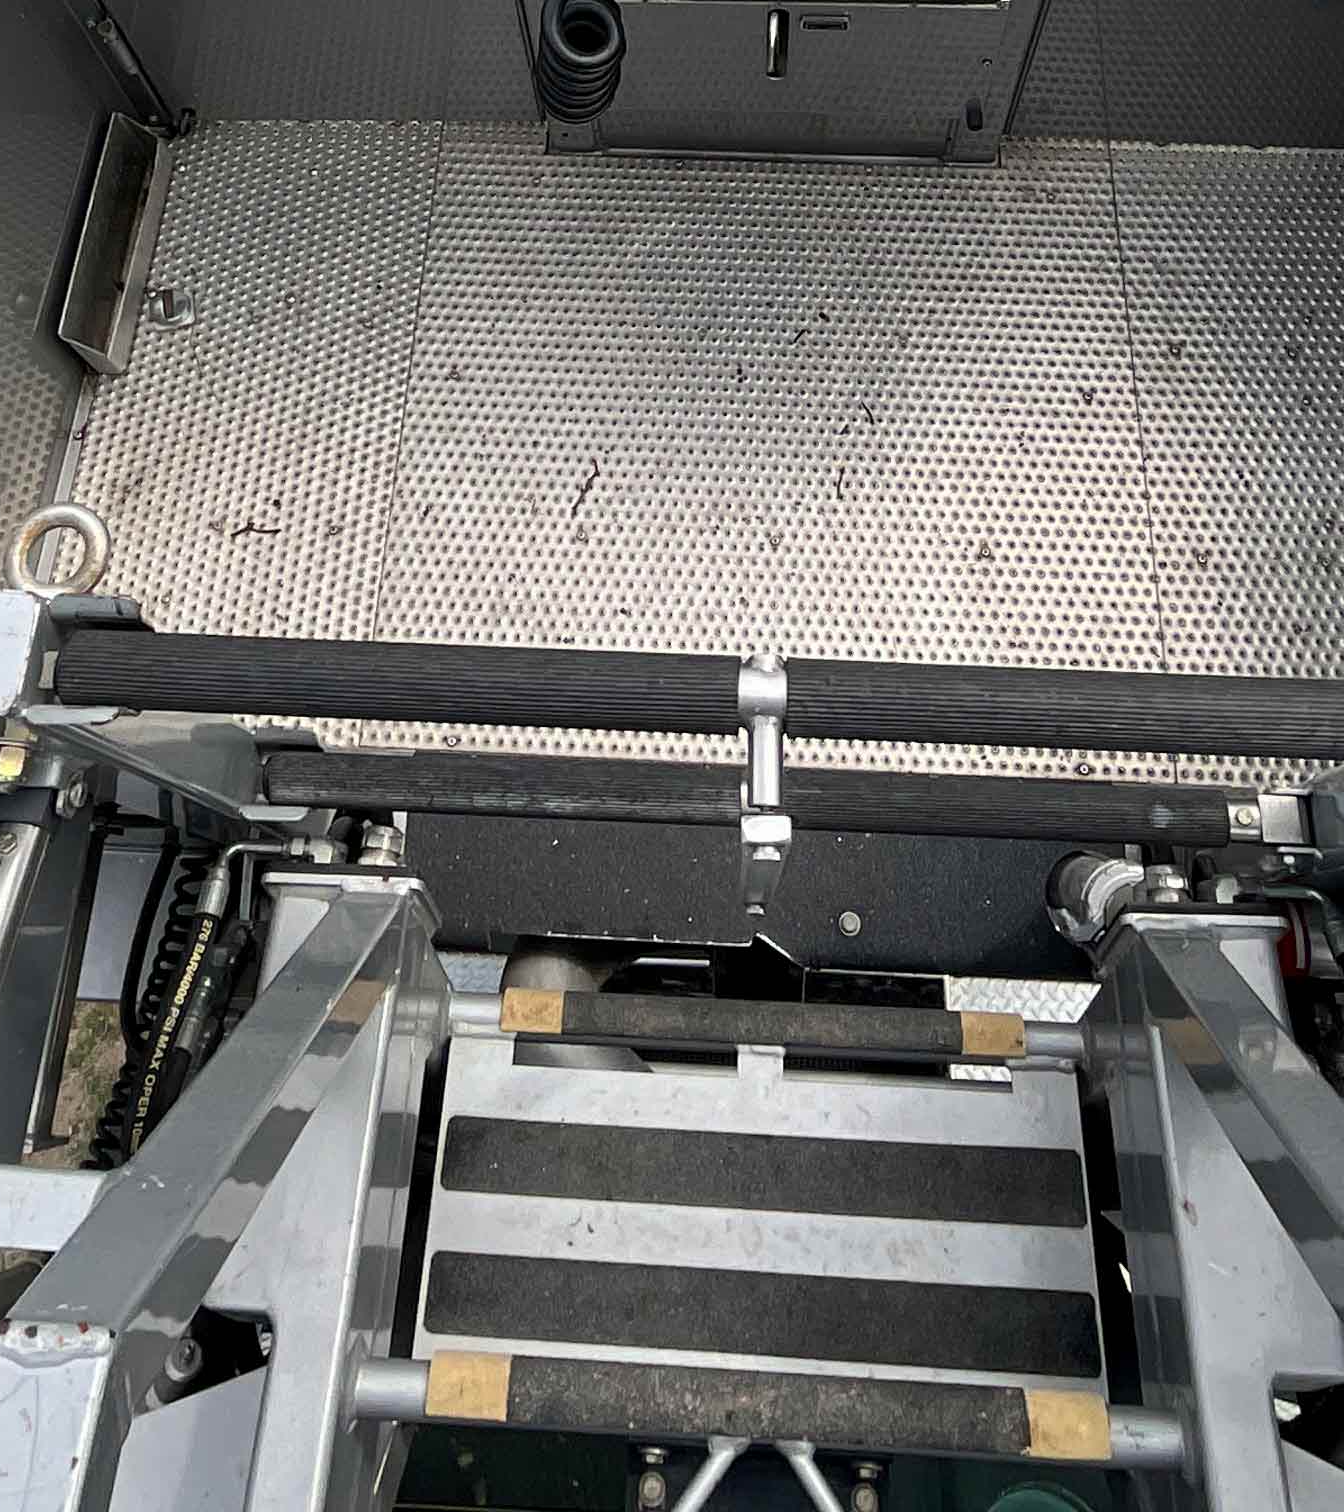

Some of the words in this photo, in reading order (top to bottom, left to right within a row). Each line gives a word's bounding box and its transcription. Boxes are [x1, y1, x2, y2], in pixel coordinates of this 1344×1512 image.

[199, 919, 213, 942] 276
[174, 942, 206, 1006] BAR/4000
[163, 1006, 181, 1034] PSI
[149, 1034, 170, 1070] MAX
[135, 1074, 156, 1119] OPER
